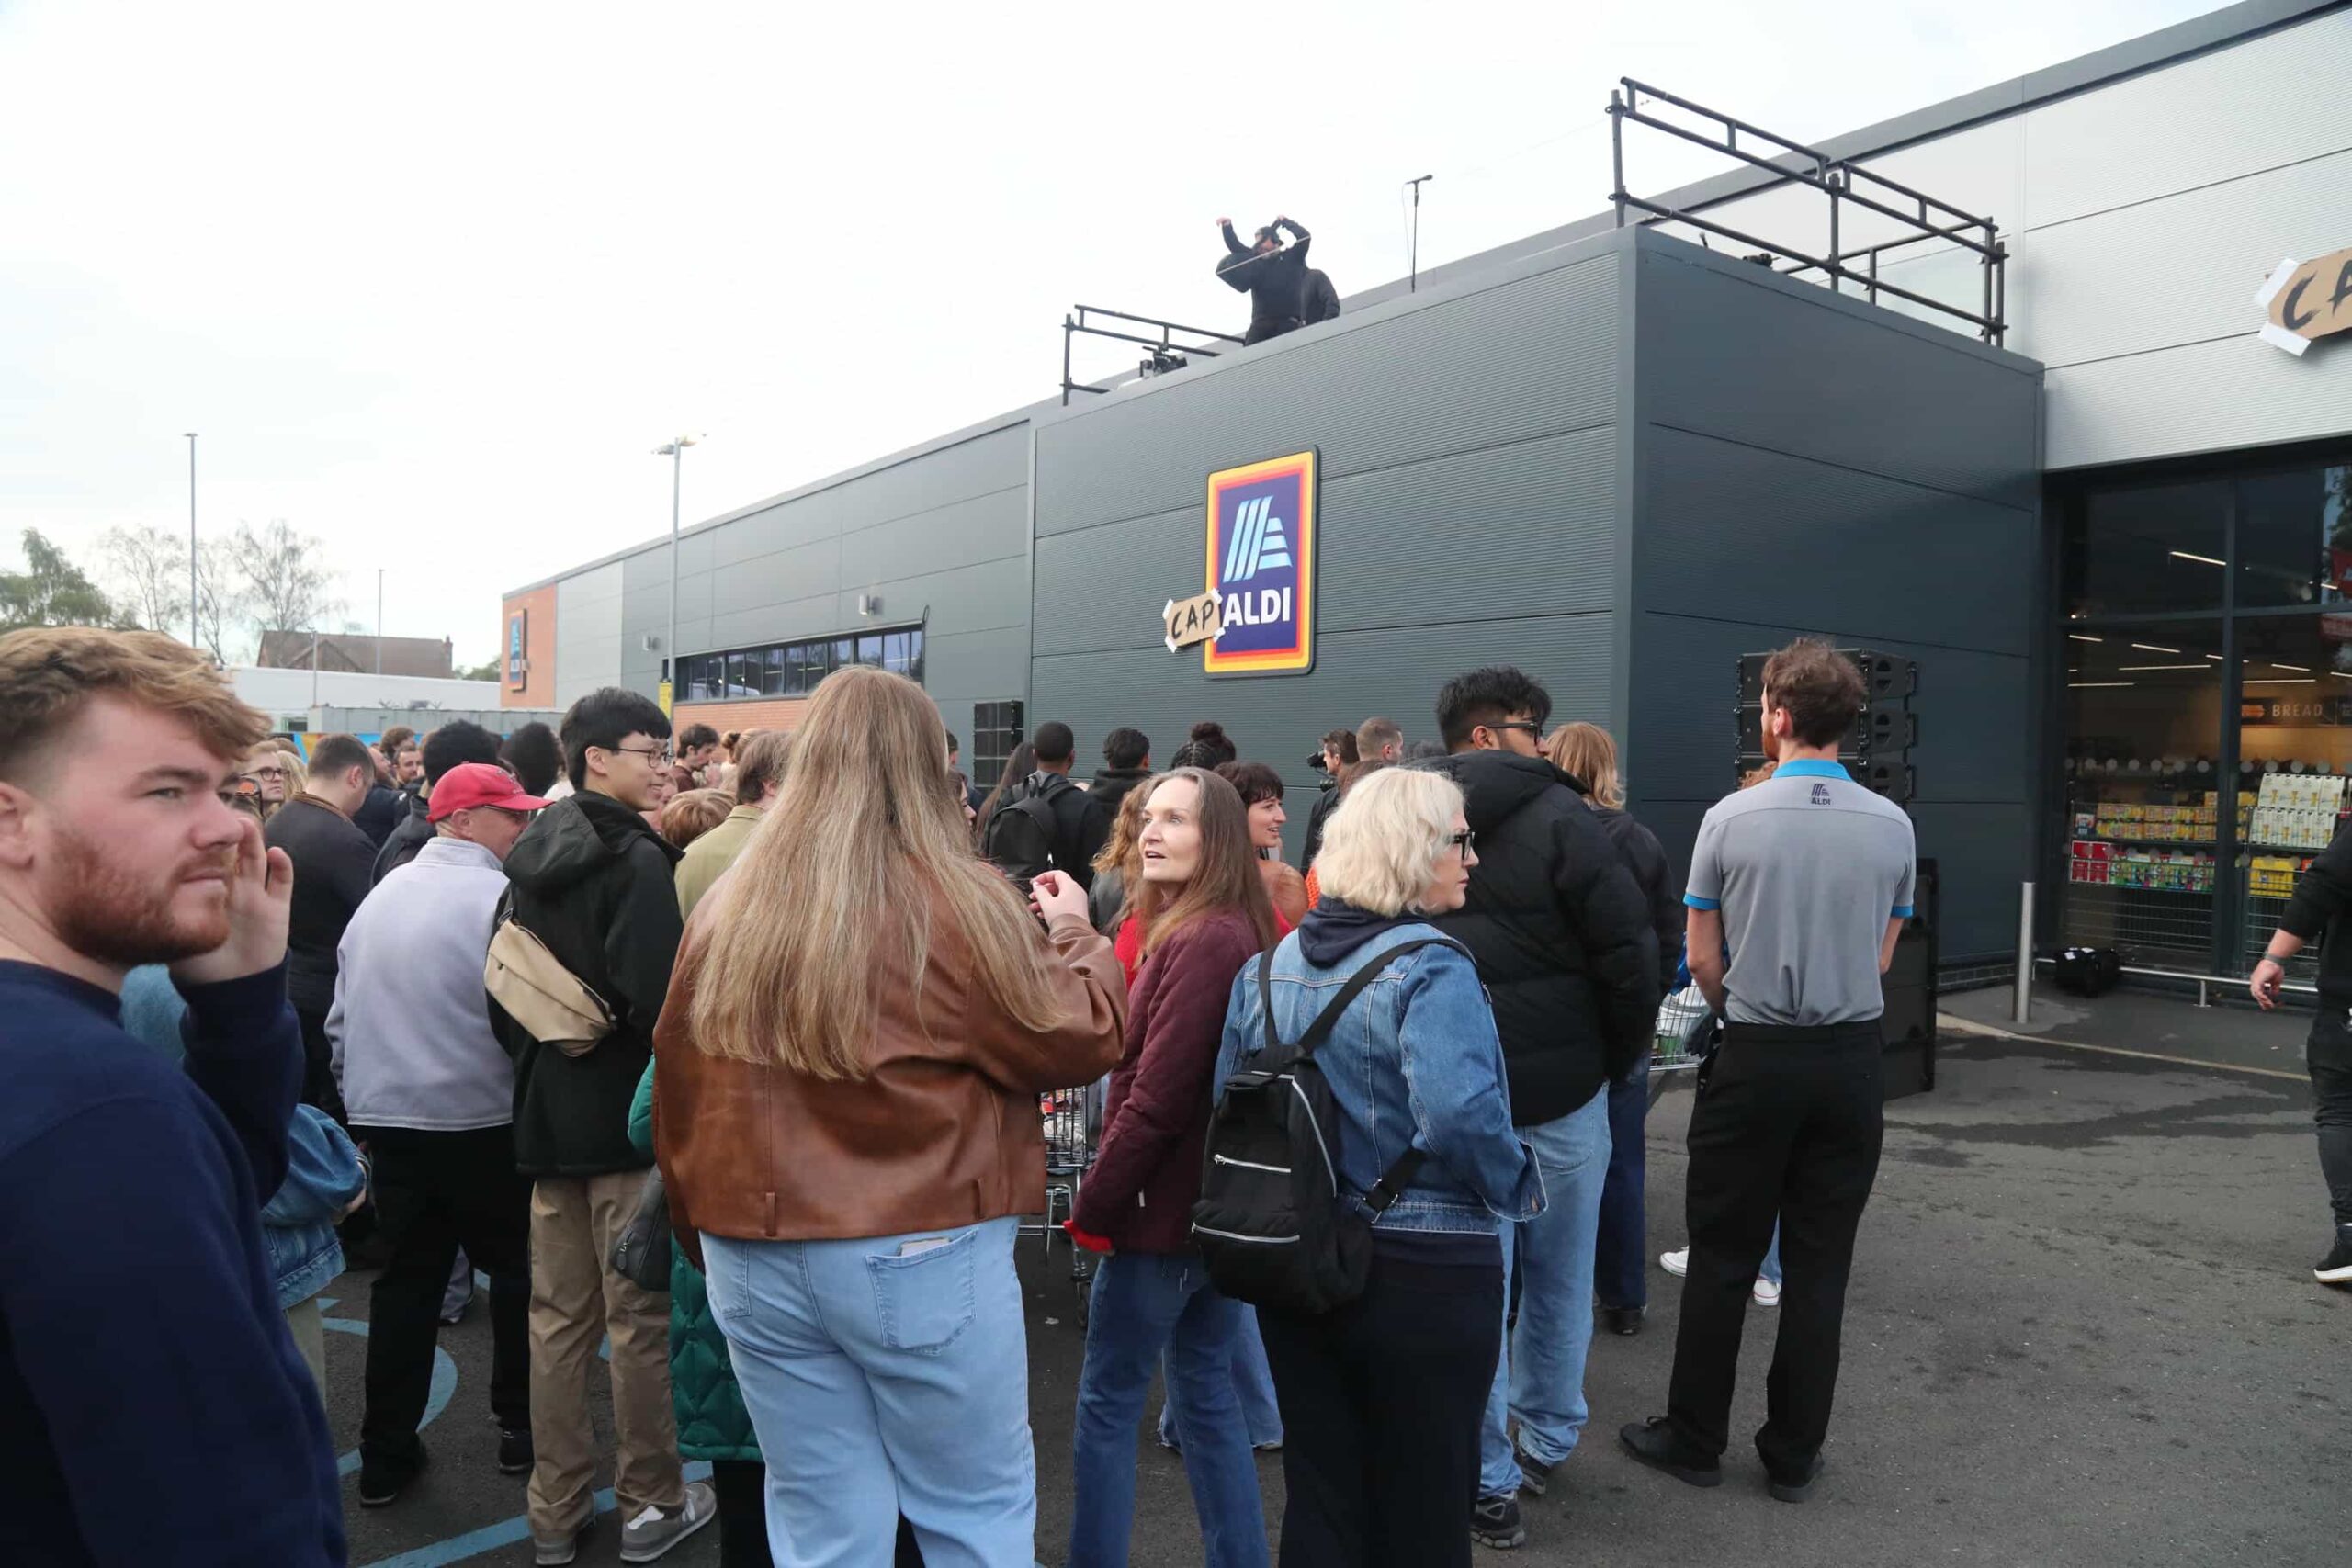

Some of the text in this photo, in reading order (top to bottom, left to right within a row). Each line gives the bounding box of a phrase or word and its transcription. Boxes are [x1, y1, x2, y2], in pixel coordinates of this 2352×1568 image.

[1171, 599, 1214, 639] CAP
[1222, 587, 1291, 627] ALDI
[2272, 704, 2324, 717] BREAD
[1811, 797, 1831, 806] ALDI
